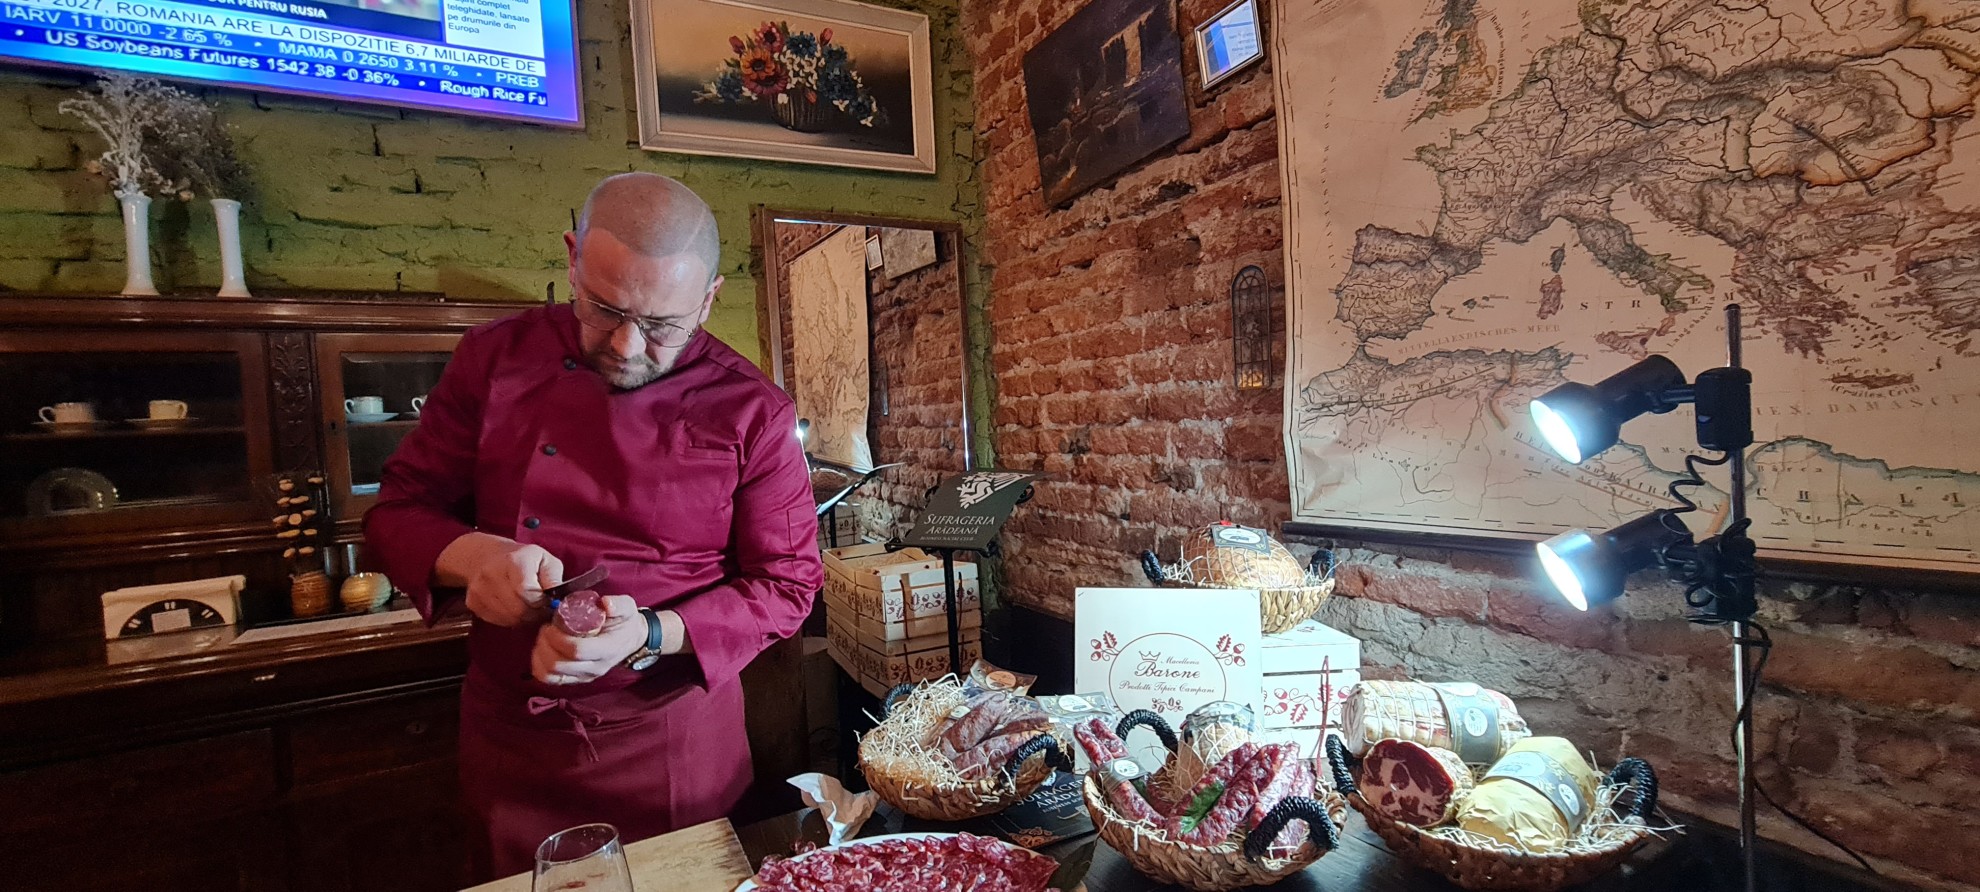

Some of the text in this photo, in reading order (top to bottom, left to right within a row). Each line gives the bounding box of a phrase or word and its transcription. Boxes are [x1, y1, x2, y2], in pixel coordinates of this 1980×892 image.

[290, 4, 328, 19] RUSIA
[447, 13, 459, 21] pe
[448, 22, 480, 34] Europa
[116, 1, 217, 28] ROMANIA
[222, 17, 263, 34] ARE
[269, 23, 294, 37] LA
[299, 27, 400, 53] DISPOZITIE
[434, 47, 511, 69] MILIARDE
[515, 59, 537, 73] DE
[5, 5, 61, 24] IARV
[278, 41, 338, 60] MAMA
[495, 71, 540, 88] PREB
[45, 29, 80, 46] US
[84, 33, 185, 59] Soybeans
[440, 80, 489, 98] Rough
[492, 87, 525, 102] Rice
[528, 92, 547, 105] Fu
[924, 513, 995, 525] SUFRAGERIA
[1134, 660, 1200, 679] Barone
